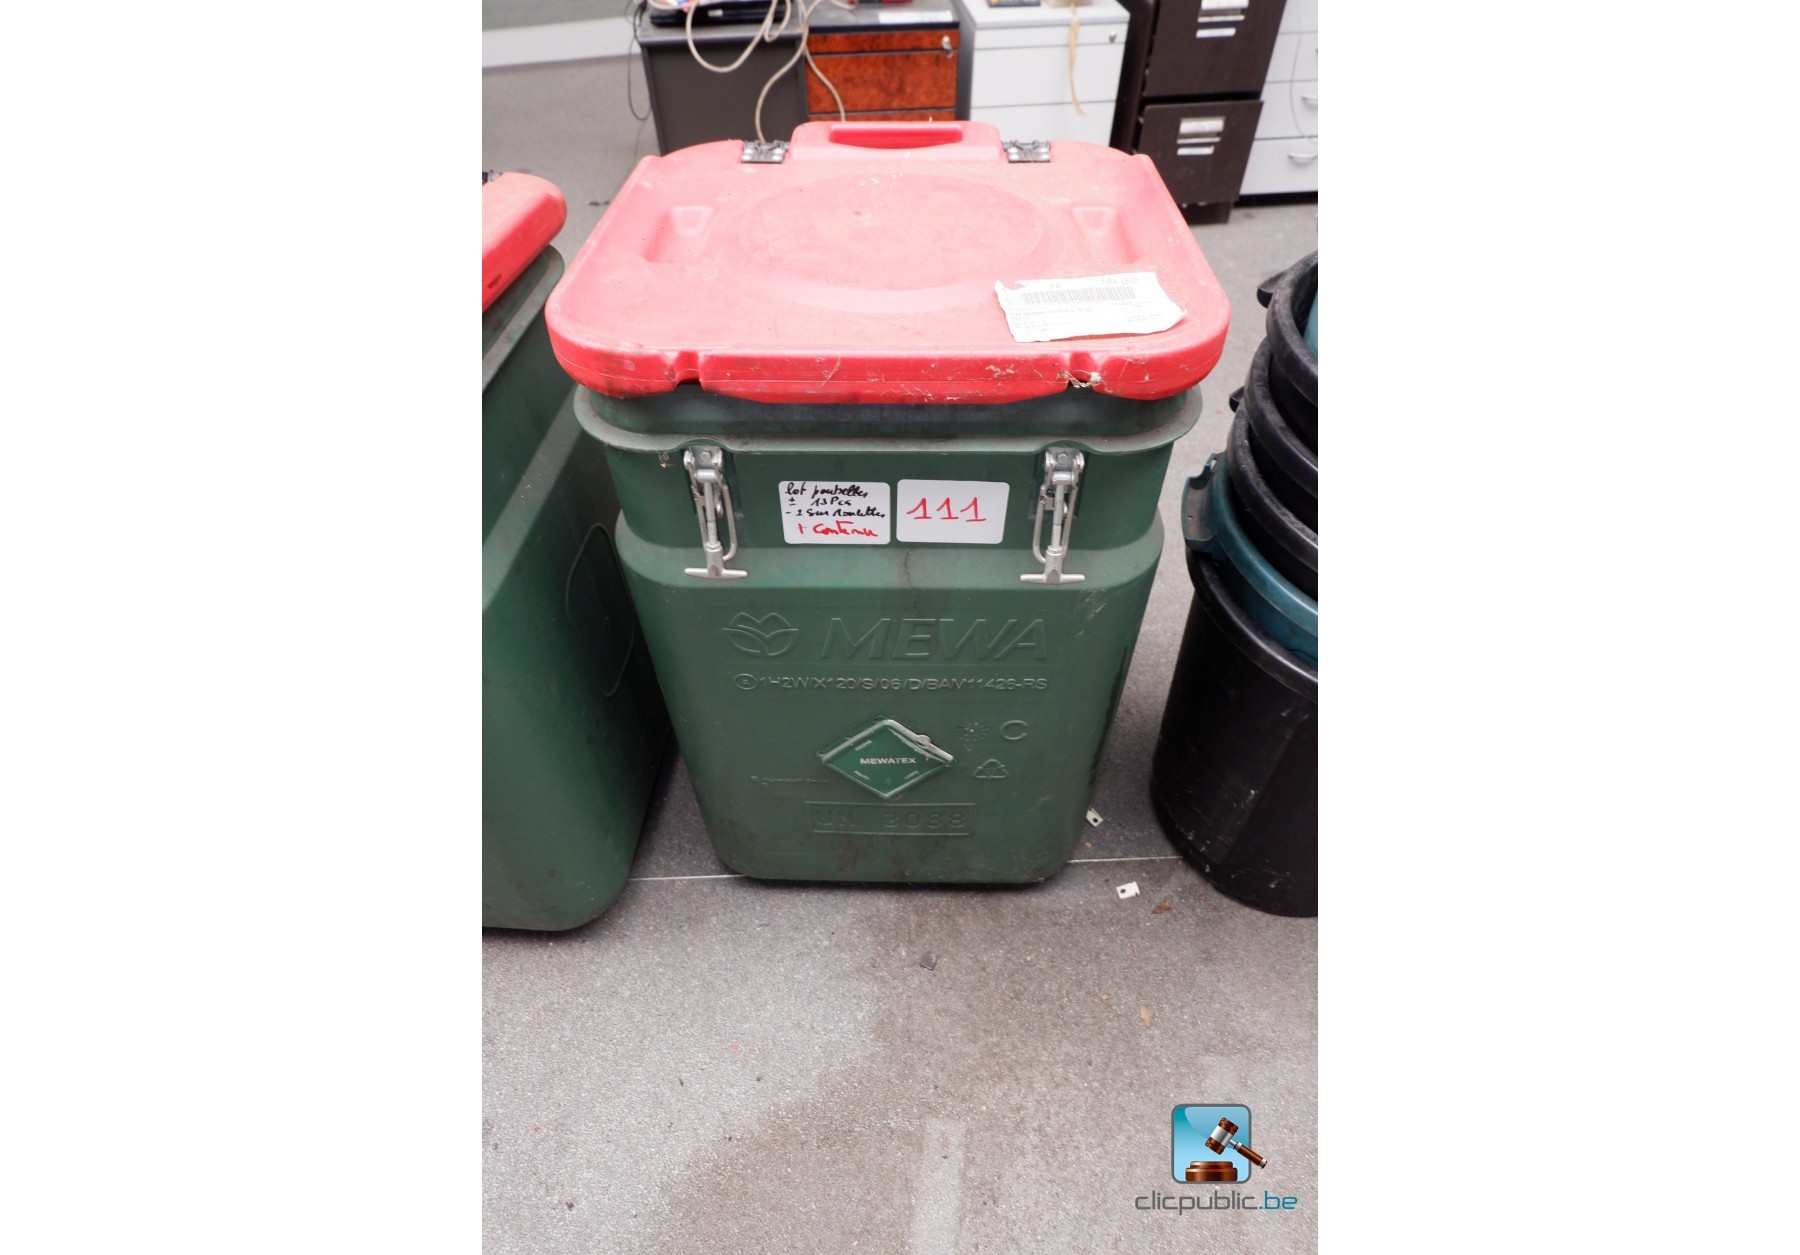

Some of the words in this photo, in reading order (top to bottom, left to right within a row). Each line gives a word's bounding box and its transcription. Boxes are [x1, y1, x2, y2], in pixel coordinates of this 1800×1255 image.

[785, 482, 806, 495] lot
[906, 497, 987, 523] 111
[820, 617, 1048, 660] MEWA
[860, 757, 916, 765] MEWATEX
[883, 811, 965, 829] 3088
